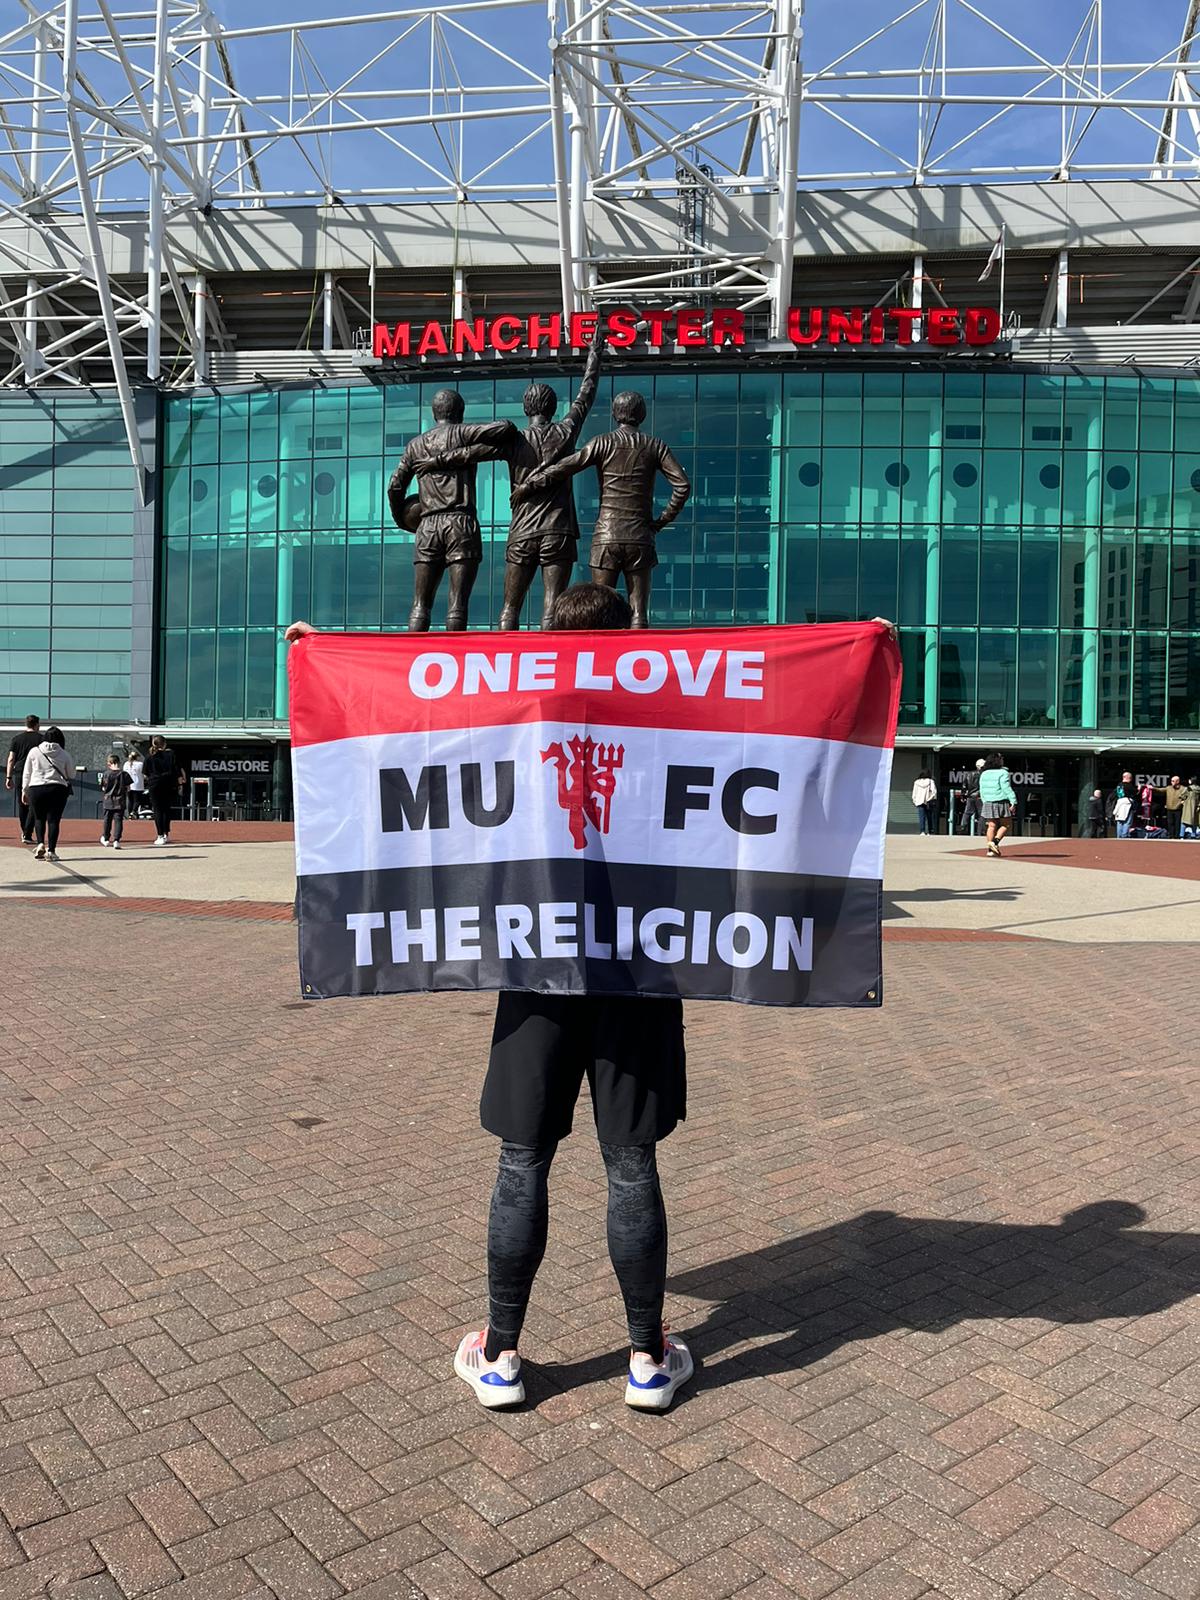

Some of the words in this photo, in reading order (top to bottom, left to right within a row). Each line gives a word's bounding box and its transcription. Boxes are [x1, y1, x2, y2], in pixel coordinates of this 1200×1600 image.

[373, 309, 745, 358] MANCHESTER
[787, 306, 1001, 346] UNITED
[408, 652, 558, 700] ONE
[575, 649, 766, 701] LOVE
[191, 760, 270, 772] MEGASTORE
[1135, 774, 1170, 787] EXIT
[379, 759, 515, 833] MU
[663, 764, 780, 835] FC
[346, 906, 483, 967] THE
[495, 902, 814, 971] RELIGION
